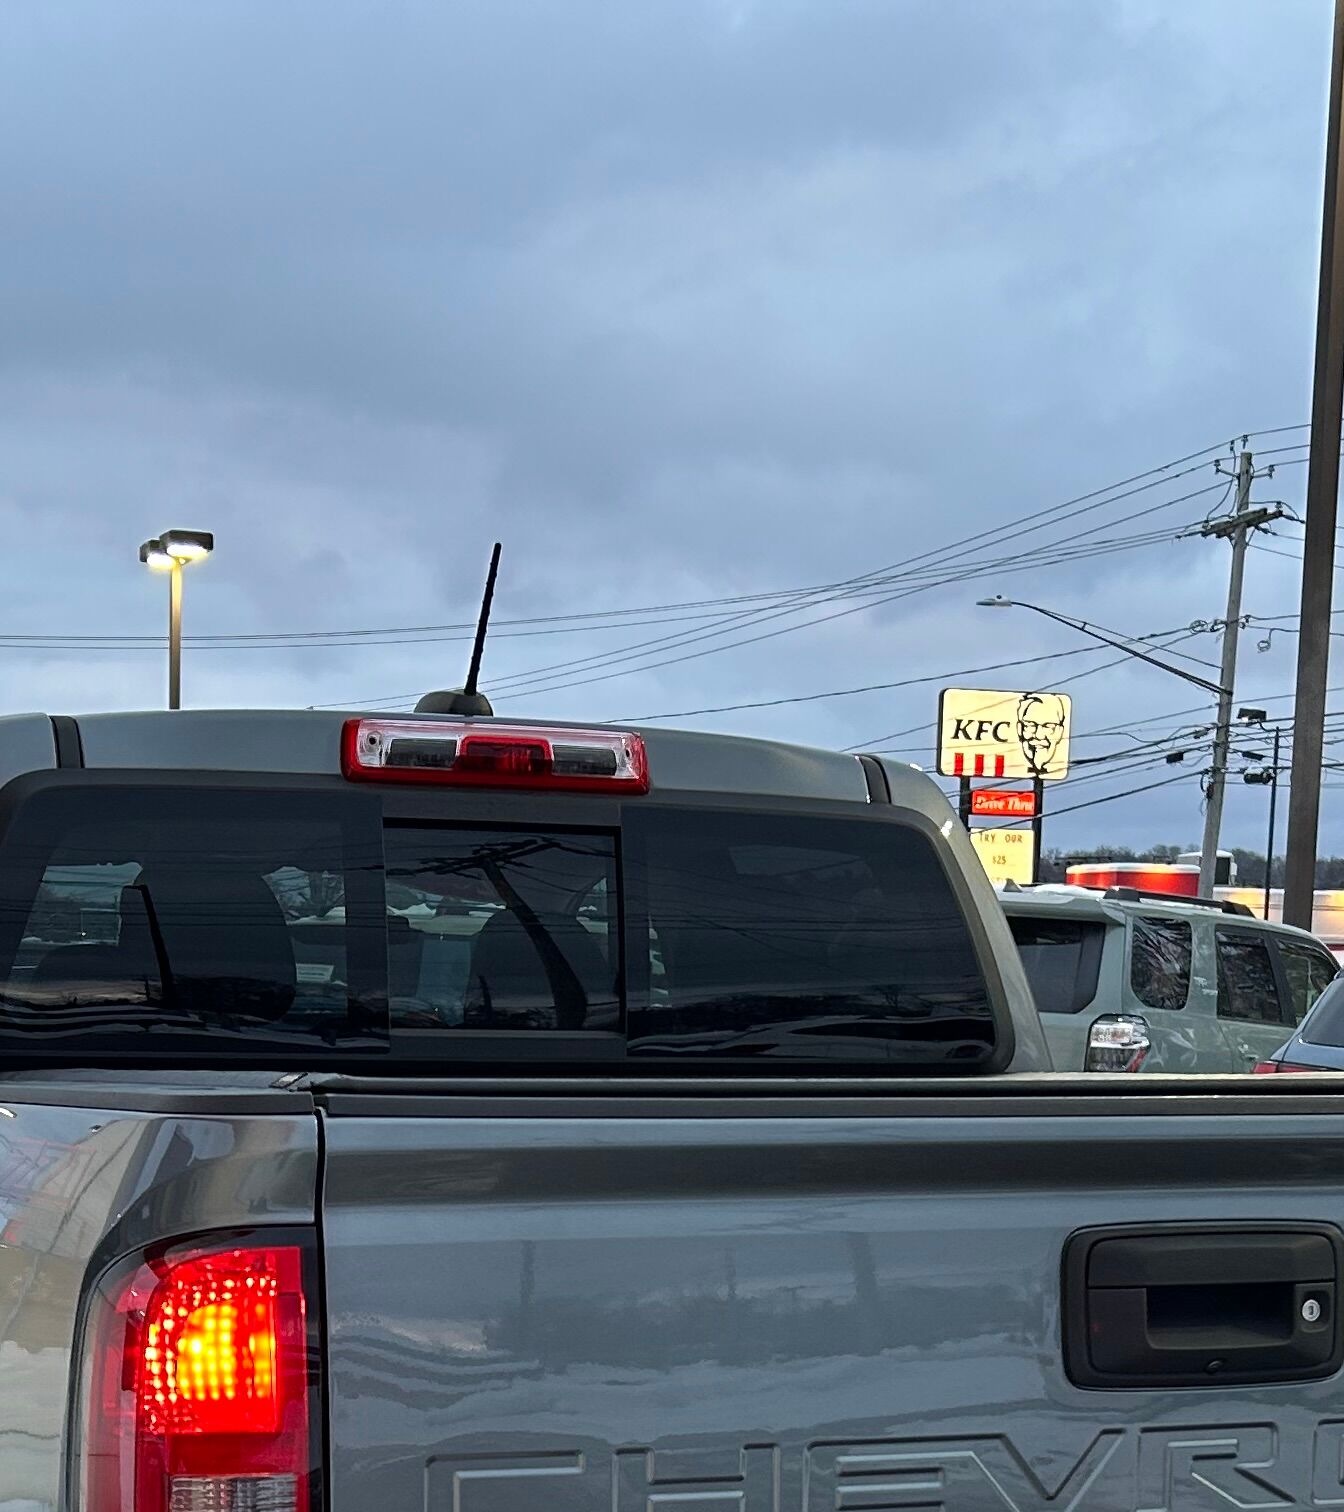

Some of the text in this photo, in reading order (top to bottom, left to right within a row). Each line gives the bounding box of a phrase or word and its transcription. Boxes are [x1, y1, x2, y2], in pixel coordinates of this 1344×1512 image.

[951, 719, 1011, 742] KFC
[975, 797, 1034, 812] Drive Thru
[979, 832, 1023, 843] TRY OUR
